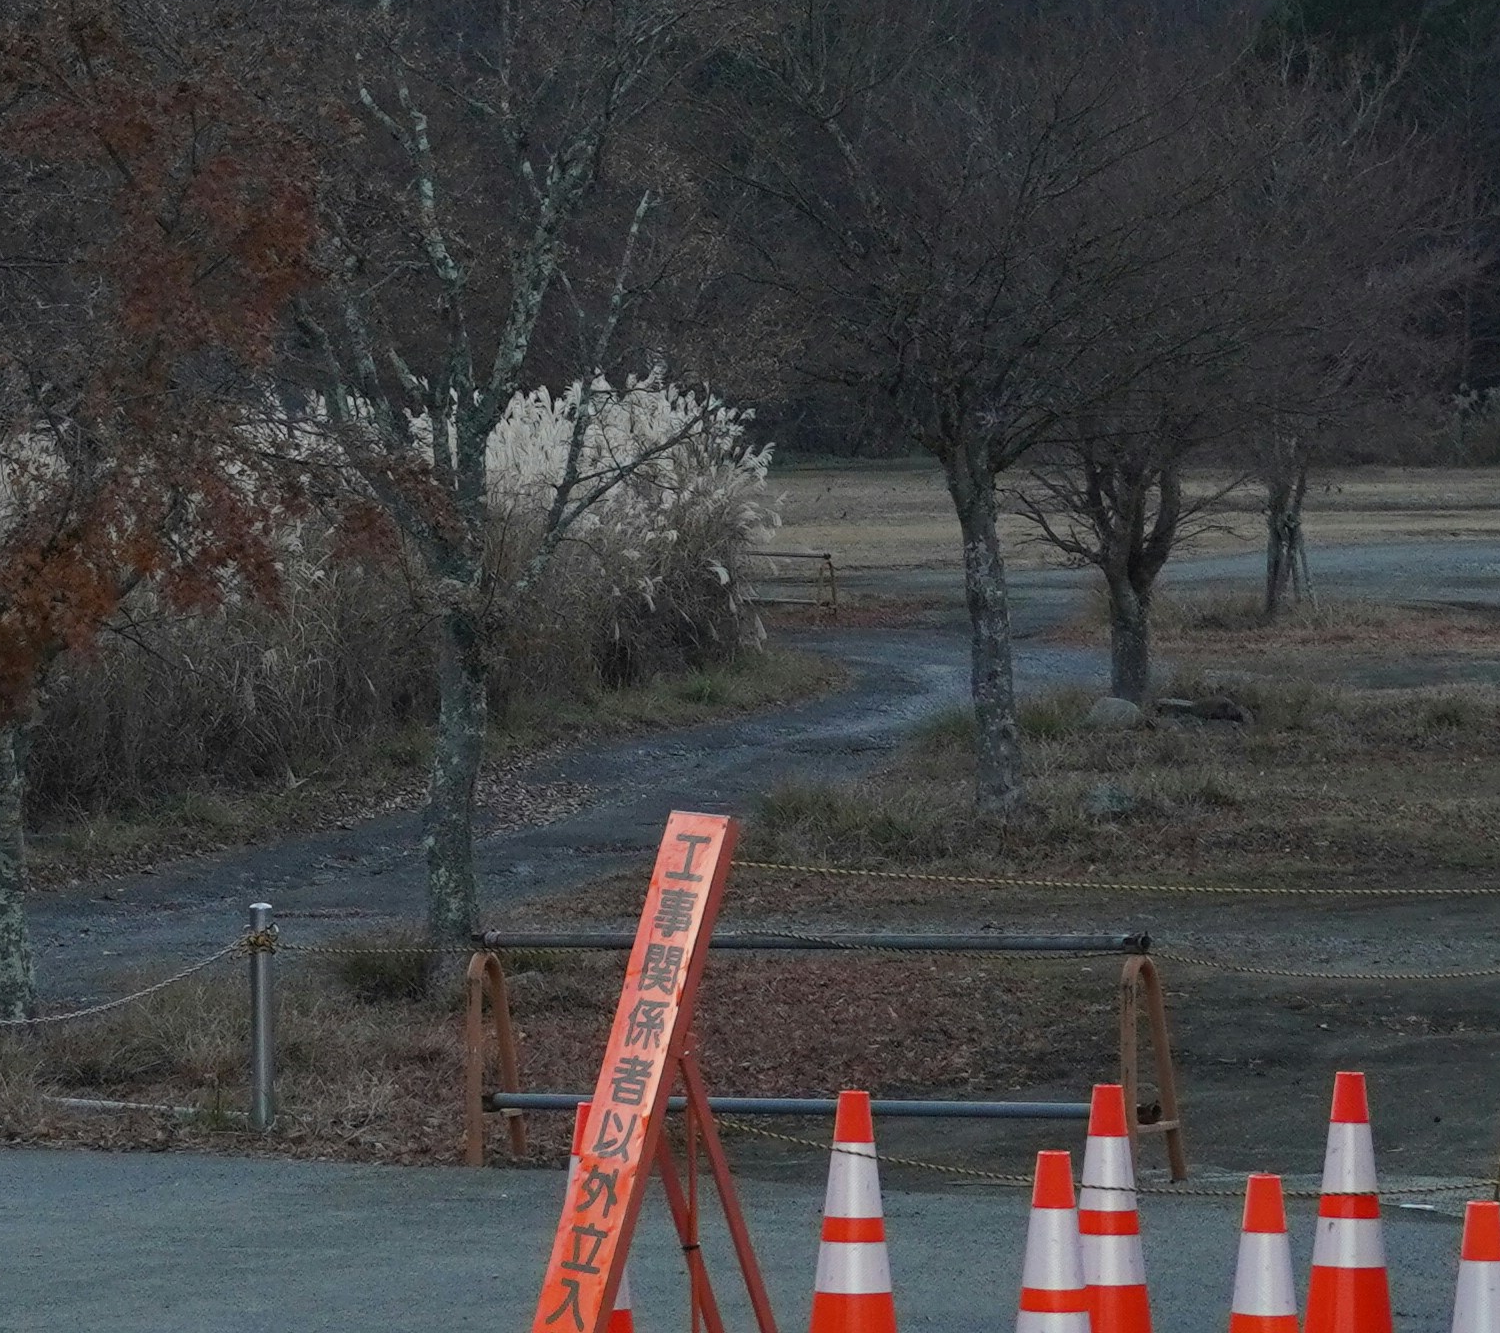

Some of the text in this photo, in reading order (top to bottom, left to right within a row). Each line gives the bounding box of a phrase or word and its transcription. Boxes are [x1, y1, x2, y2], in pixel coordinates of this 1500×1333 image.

[545, 833, 712, 1332] 工事関係者以外立入
